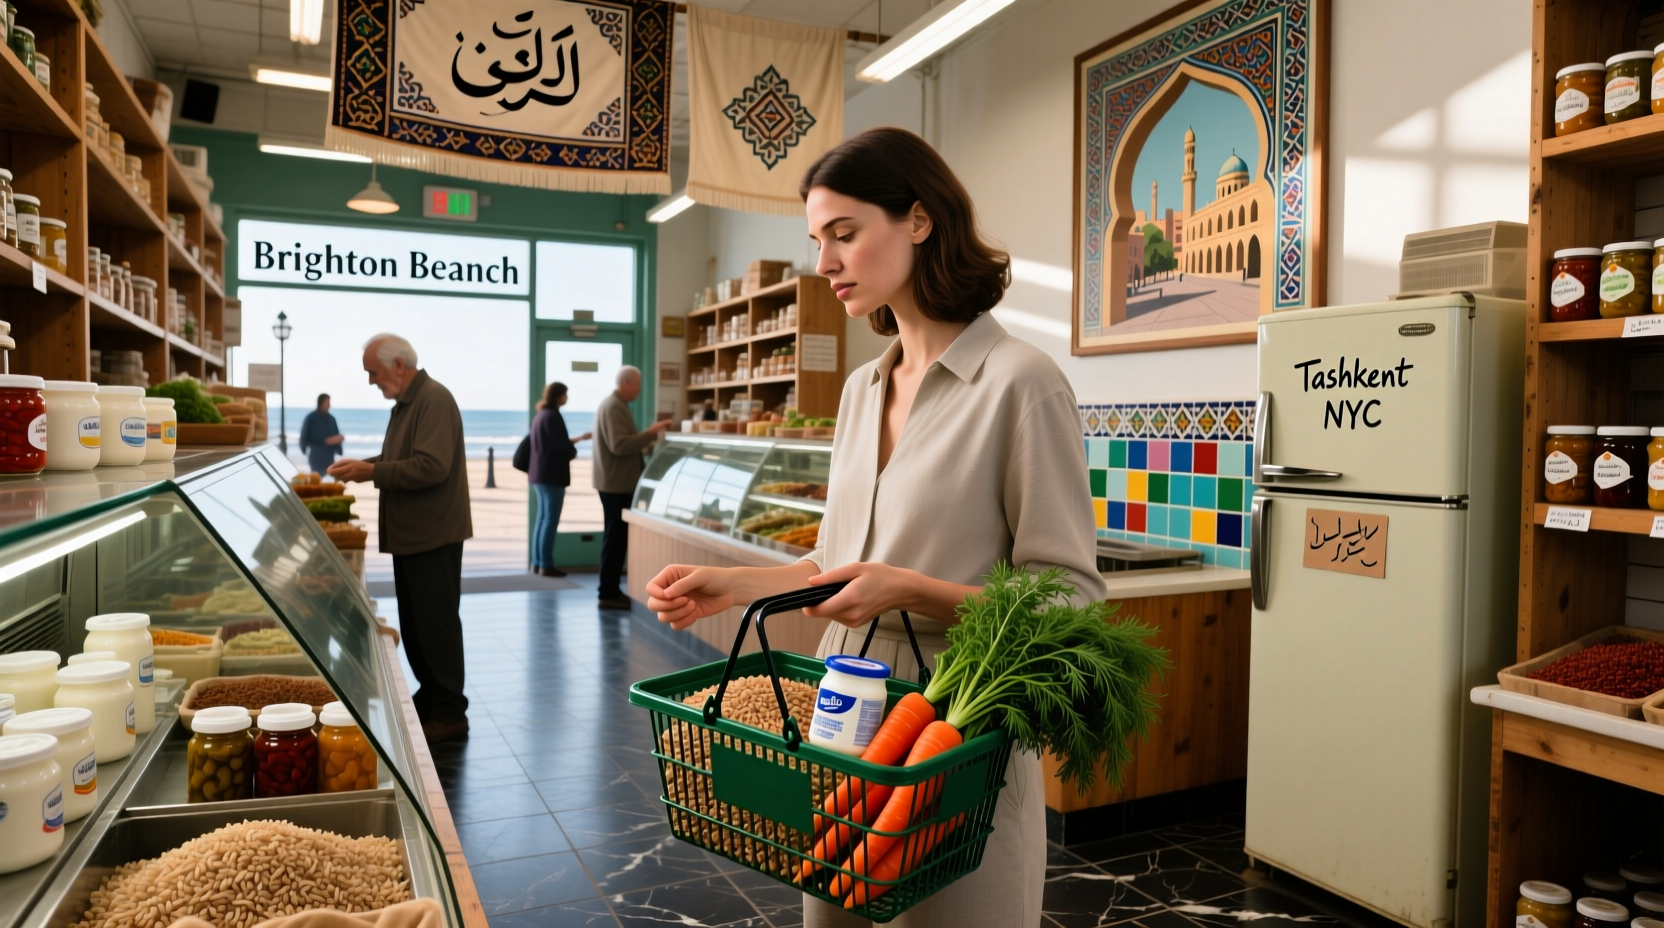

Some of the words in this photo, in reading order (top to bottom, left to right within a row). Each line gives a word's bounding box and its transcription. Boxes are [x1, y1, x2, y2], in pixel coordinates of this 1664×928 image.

[254, 241, 397, 281] Brighton
[409, 251, 519, 285] Beanch
[1294, 356, 1414, 393] Tashkent
[1323, 399, 1382, 431] NYC
